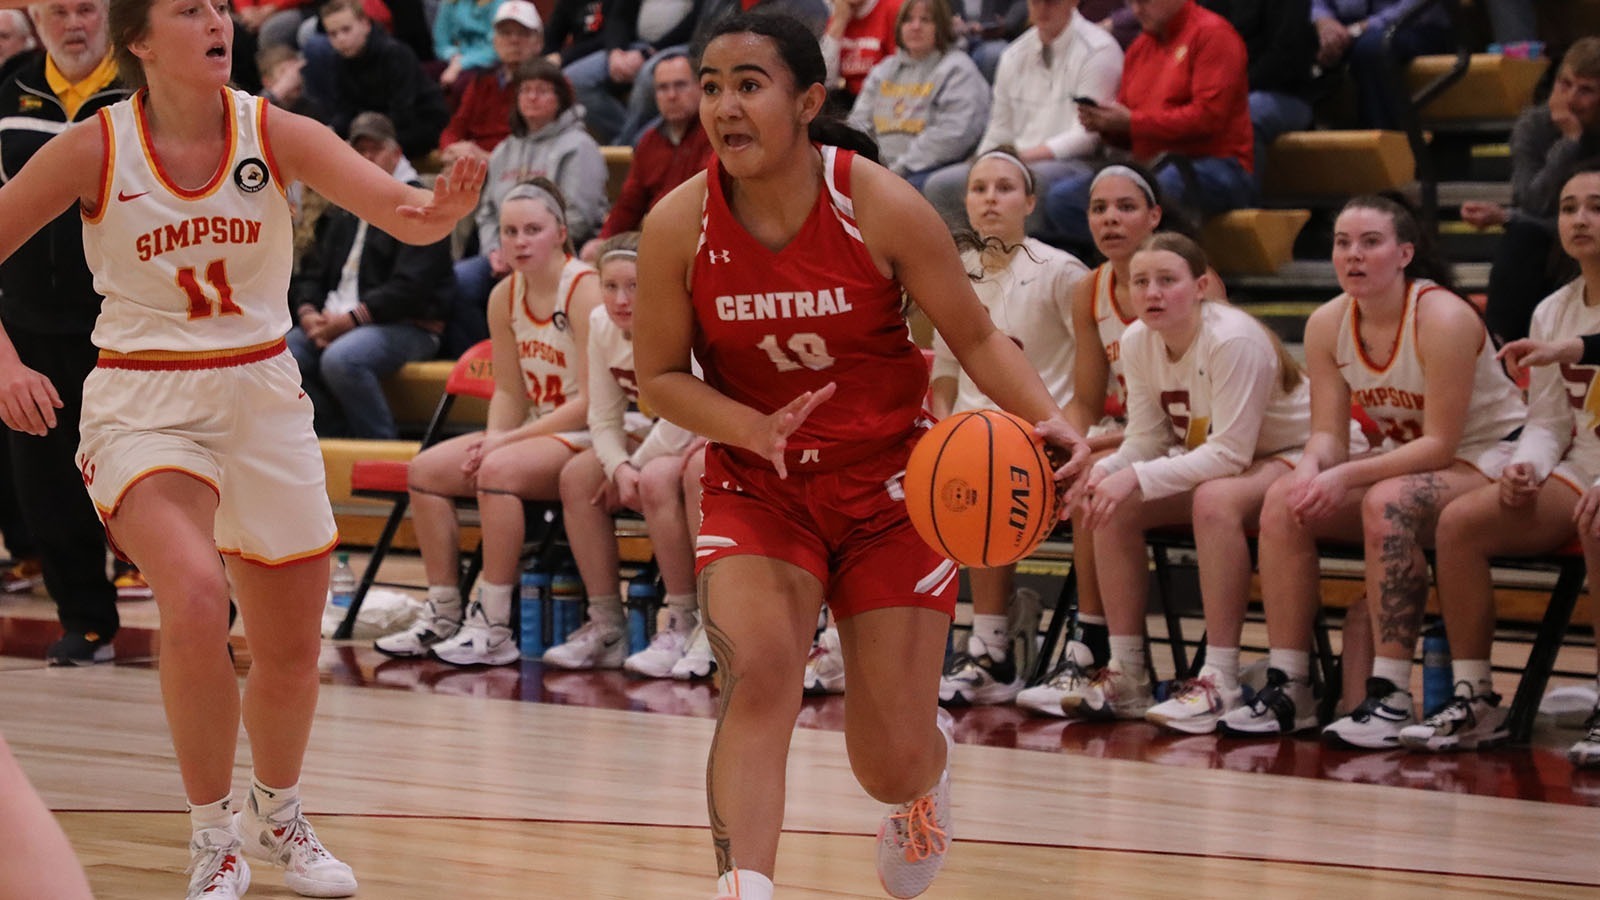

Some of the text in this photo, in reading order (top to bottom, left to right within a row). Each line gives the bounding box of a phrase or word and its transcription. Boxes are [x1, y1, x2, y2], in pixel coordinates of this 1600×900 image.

[136, 216, 262, 262] SIMPSON
[176, 258, 245, 321] 11
[715, 287, 853, 321] CENTRAL
[520, 340, 566, 369] MPSON
[1357, 386, 1425, 411] MPSON
[1009, 465, 1030, 530] EVO
